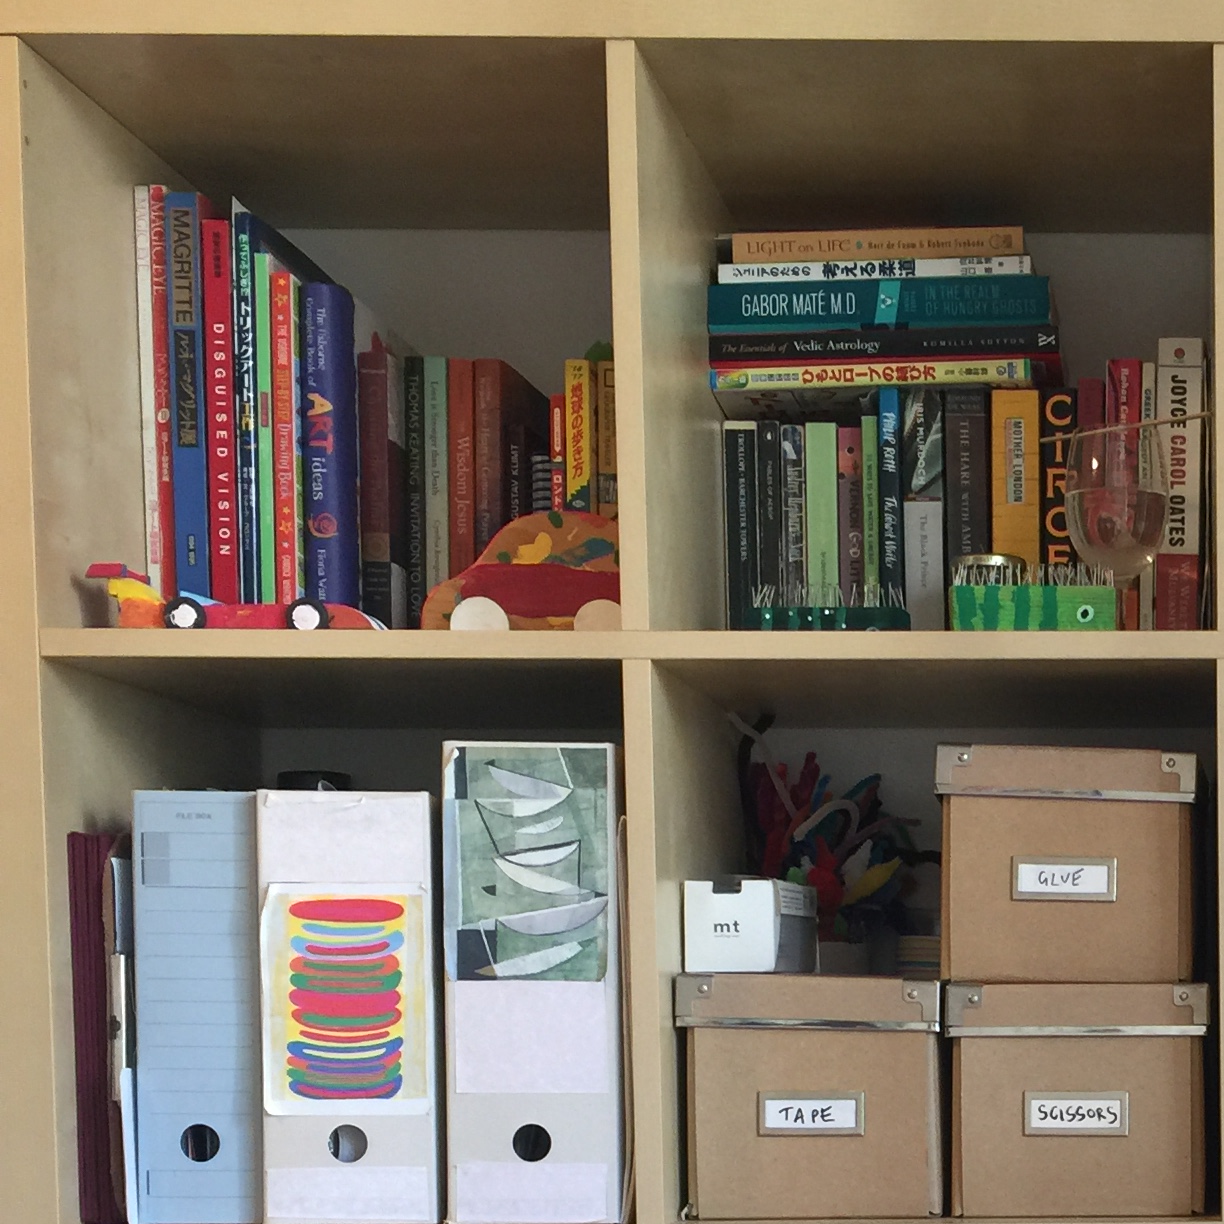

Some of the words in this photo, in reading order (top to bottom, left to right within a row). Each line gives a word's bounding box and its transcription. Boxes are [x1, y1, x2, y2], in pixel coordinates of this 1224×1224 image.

[150, 200, 164, 259] MAGIC
[745, 240, 796, 254] LIGHT
[798, 244, 813, 254] on
[153, 264, 166, 296] EYE
[172, 208, 194, 323] MAGRITTE
[732, 265, 811, 278] ジュニアのための
[821, 259, 917, 280] 考える柔道
[316, 307, 327, 325] The
[741, 294, 788, 317] GABOR
[792, 289, 826, 316] MATÉ
[829, 292, 860, 315] M.D.
[306, 347, 317, 373] Book
[316, 328, 328, 370] Usborne
[721, 342, 737, 353] The
[793, 339, 823, 351] Vedic
[826, 338, 881, 353] Astrology
[213, 322, 228, 458] DISGUISED
[407, 374, 420, 429] THOMAS
[1144, 388, 1152, 419] GREEK
[1169, 374, 1188, 429] JOYCE
[306, 392, 335, 454] ART
[882, 412, 897, 446] PHILIP
[915, 402, 924, 424] IRIS
[277, 423, 292, 470] Drawing
[570, 382, 585, 480] 地球の歩き方
[959, 419, 970, 446] THE
[1013, 420, 1024, 459] MOTHER
[408, 432, 421, 485] KEATING
[455, 435, 470, 495] Wisdom
[510, 444, 519, 475] KLIMT
[883, 447, 897, 473] ROTH
[916, 426, 926, 485] MURDOCH
[959, 451, 970, 487] HARE
[1169, 434, 1188, 489] CAROL
[278, 471, 292, 500] Book
[311, 456, 327, 501] ideas
[1013, 463, 1024, 502] LONDON
[217, 471, 231, 556] VISION
[455, 497, 471, 534] Jesus
[738, 478, 747, 528] BARCHESTER
[849, 479, 861, 529] VERNON
[1168, 494, 1186, 547] OATES
[409, 492, 422, 563] INVITATION
[919, 515, 928, 531] The
[960, 525, 971, 554] AMB
[316, 548, 328, 577] Fiona
[919, 534, 929, 557] Black
[410, 565, 421, 583] TO
[1037, 869, 1084, 888] GLUE
[713, 919, 740, 933] mt
[778, 1105, 835, 1124] TAPE
[1037, 1103, 1119, 1125] SCISSORS
